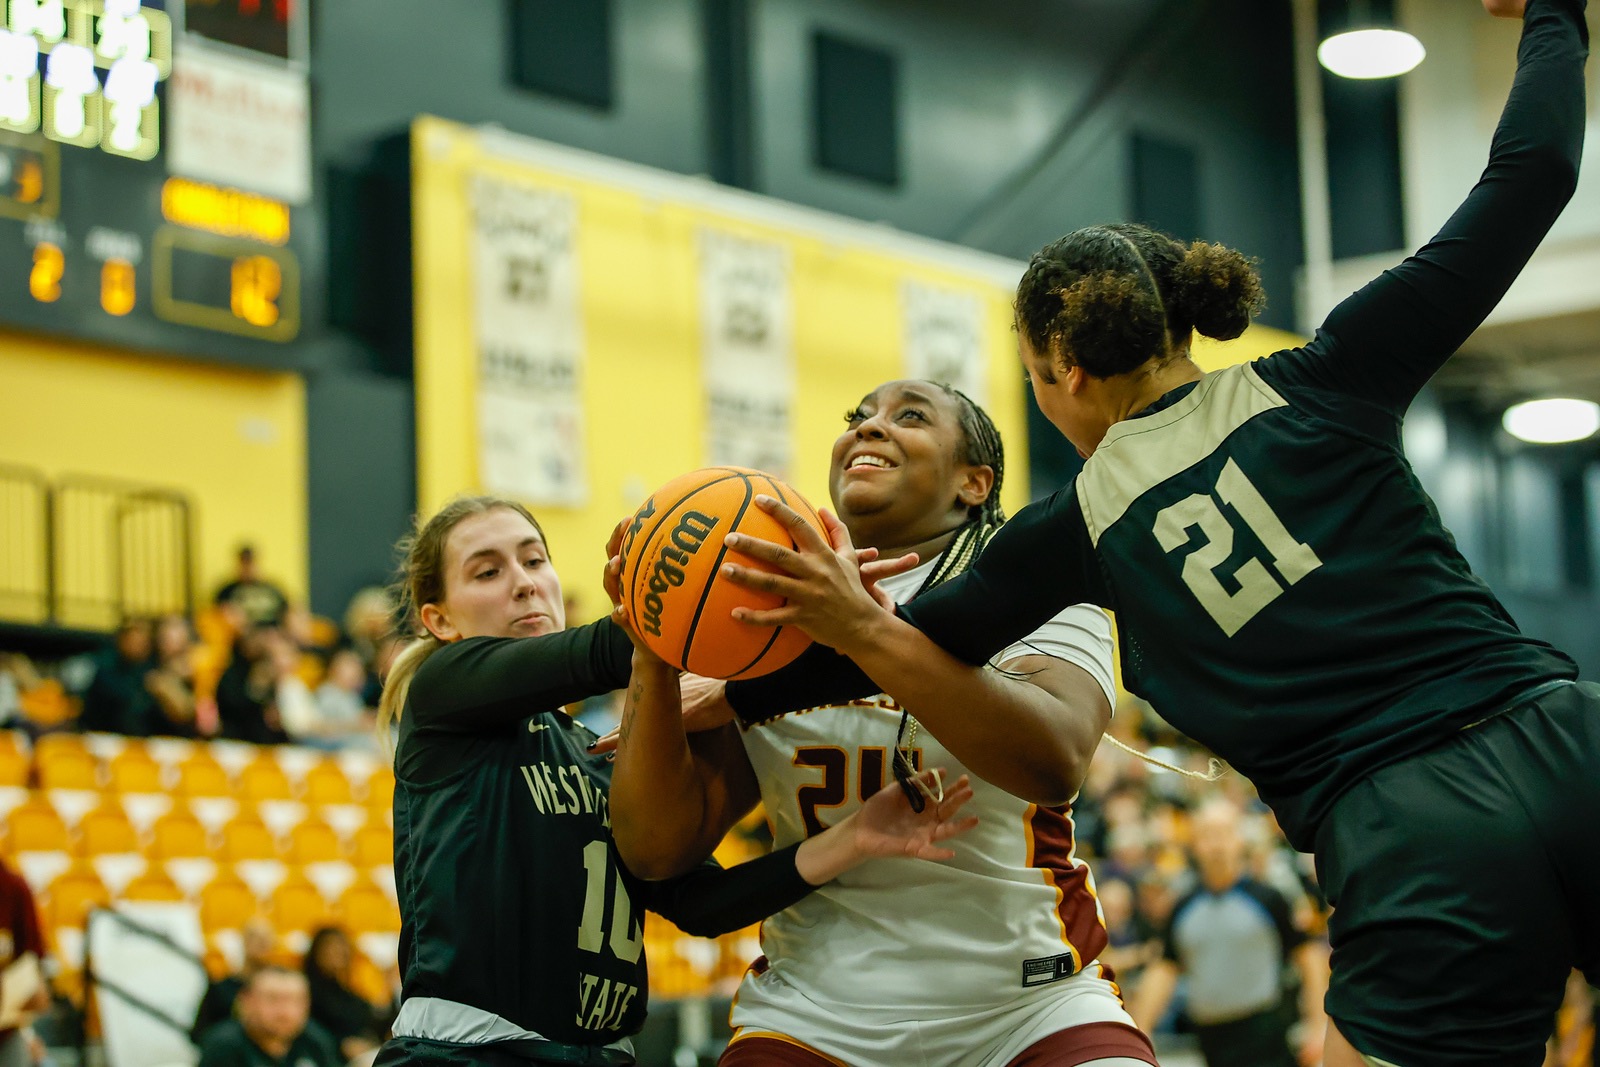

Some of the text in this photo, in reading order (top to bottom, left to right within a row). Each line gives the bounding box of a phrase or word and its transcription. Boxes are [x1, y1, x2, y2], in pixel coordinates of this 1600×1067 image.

[643, 511, 720, 637] Wilson
[1152, 456, 1324, 638] 21
[1061, 962, 1067, 974] L
